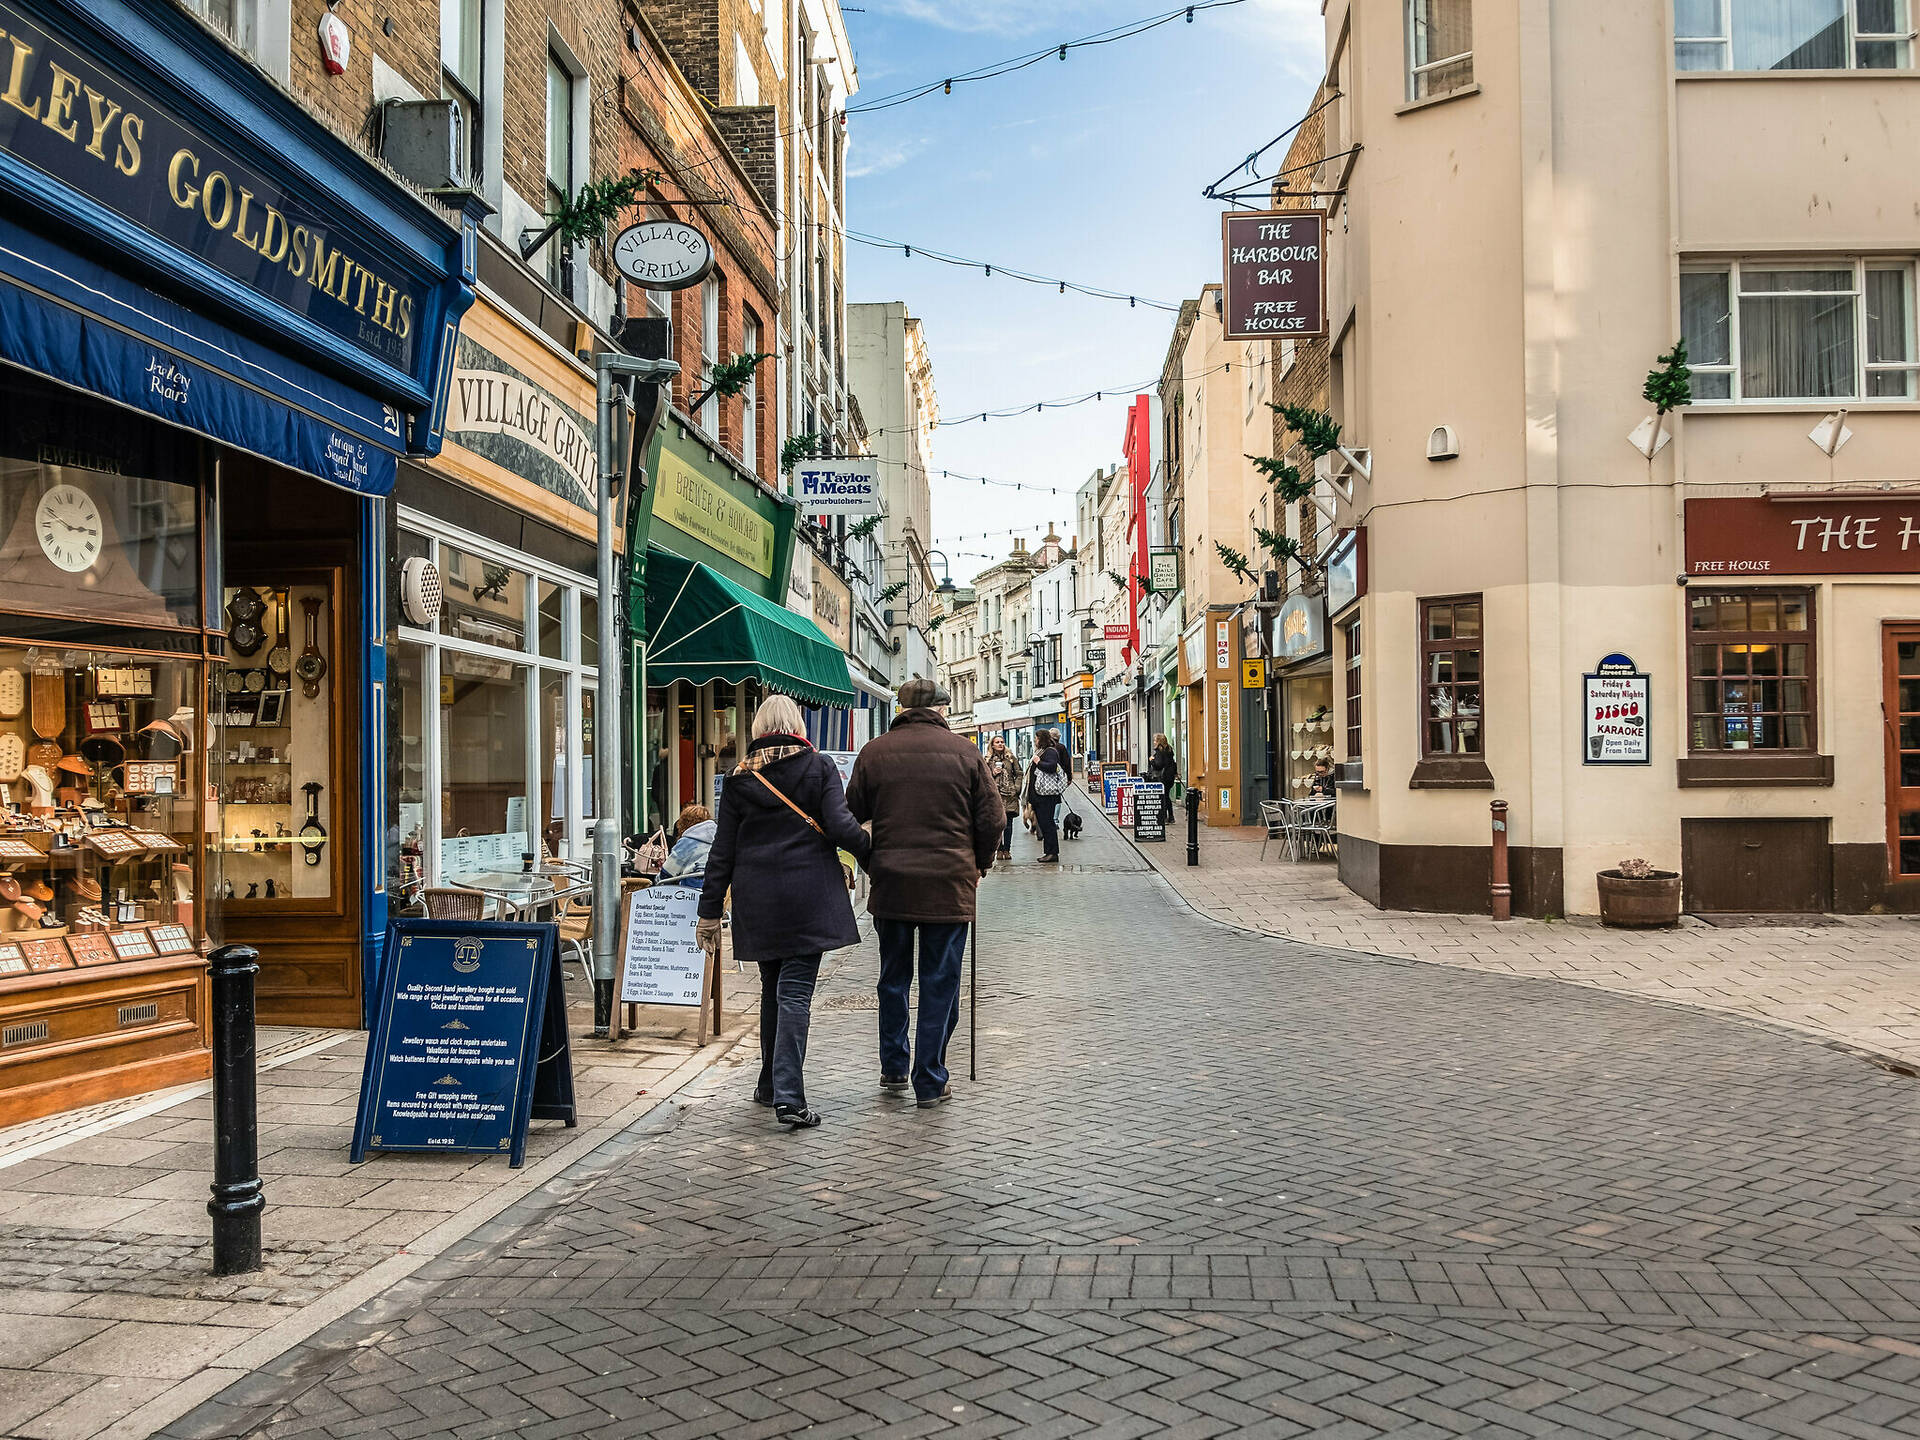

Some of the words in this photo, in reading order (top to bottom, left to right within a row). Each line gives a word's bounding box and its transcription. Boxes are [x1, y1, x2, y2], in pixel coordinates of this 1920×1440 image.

[0, 28, 144, 176] LEYS
[168, 147, 414, 340] GOLDSMITHS
[1258, 223, 1292, 240] THE
[620, 226, 702, 254] VILLAGE
[1231, 245, 1319, 264] HARBOUR
[631, 258, 690, 278] GRILL
[1257, 268, 1294, 285] BAR
[1253, 300, 1298, 315] FREE
[1244, 316, 1307, 330] HOUSE
[457, 377, 551, 446] VILLAGE
[821, 471, 871, 484] Taylor
[819, 483, 872, 495] Meats
[675, 471, 713, 517] BREWER
[716, 497, 726, 522] &
[728, 506, 758, 543] HOWARD
[1790, 515, 1881, 552] THE
[1694, 560, 1725, 572] FREE
[1728, 560, 1771, 571] HOUSE
[1602, 679, 1624, 690] Friday
[1625, 680, 1631, 688] &
[1590, 689, 1621, 700] Saturday
[1621, 690, 1644, 700] Nights
[1594, 701, 1639, 721] DISCO
[1597, 724, 1645, 737] KARAOKE
[1605, 739, 1622, 747] Open
[1623, 739, 1641, 747] Daily
[1122, 797, 1134, 807] BU
[1121, 806, 1134, 816] AN
[1121, 815, 1134, 825] SE
[646, 888, 673, 902] Village
[674, 889, 696, 902] Grill
[684, 972, 700, 980] £3.90
[407, 984, 423, 992] Quality
[425, 984, 443, 992] Second
[444, 985, 456, 993] hand
[456, 985, 477, 994] jewellery
[478, 985, 495, 994] bought
[506, 986, 517, 994] sold
[683, 990, 698, 998] £3.90
[397, 992, 408, 1000] Wide
[424, 993, 429, 1001] of
[430, 994, 441, 1002] gold
[430, 1002, 447, 1010] Clocks
[458, 1003, 485, 1011] barometers
[402, 1036, 424, 1045] Jewellery
[450, 1038, 462, 1046] clock
[463, 1038, 480, 1047] repairs
[390, 1054, 404, 1062] Watch
[450, 1056, 463, 1064] minor
[464, 1056, 480, 1065] repairs
[481, 1057, 494, 1065] while
[495, 1058, 503, 1066] you
[416, 1091, 427, 1099] Free
[438, 1093, 459, 1101] wrapping
[421, 1101, 428, 1109] by
[433, 1102, 451, 1110] deposit
[463, 1103, 480, 1111] regular
[393, 1110, 428, 1119] Knowledgeable
